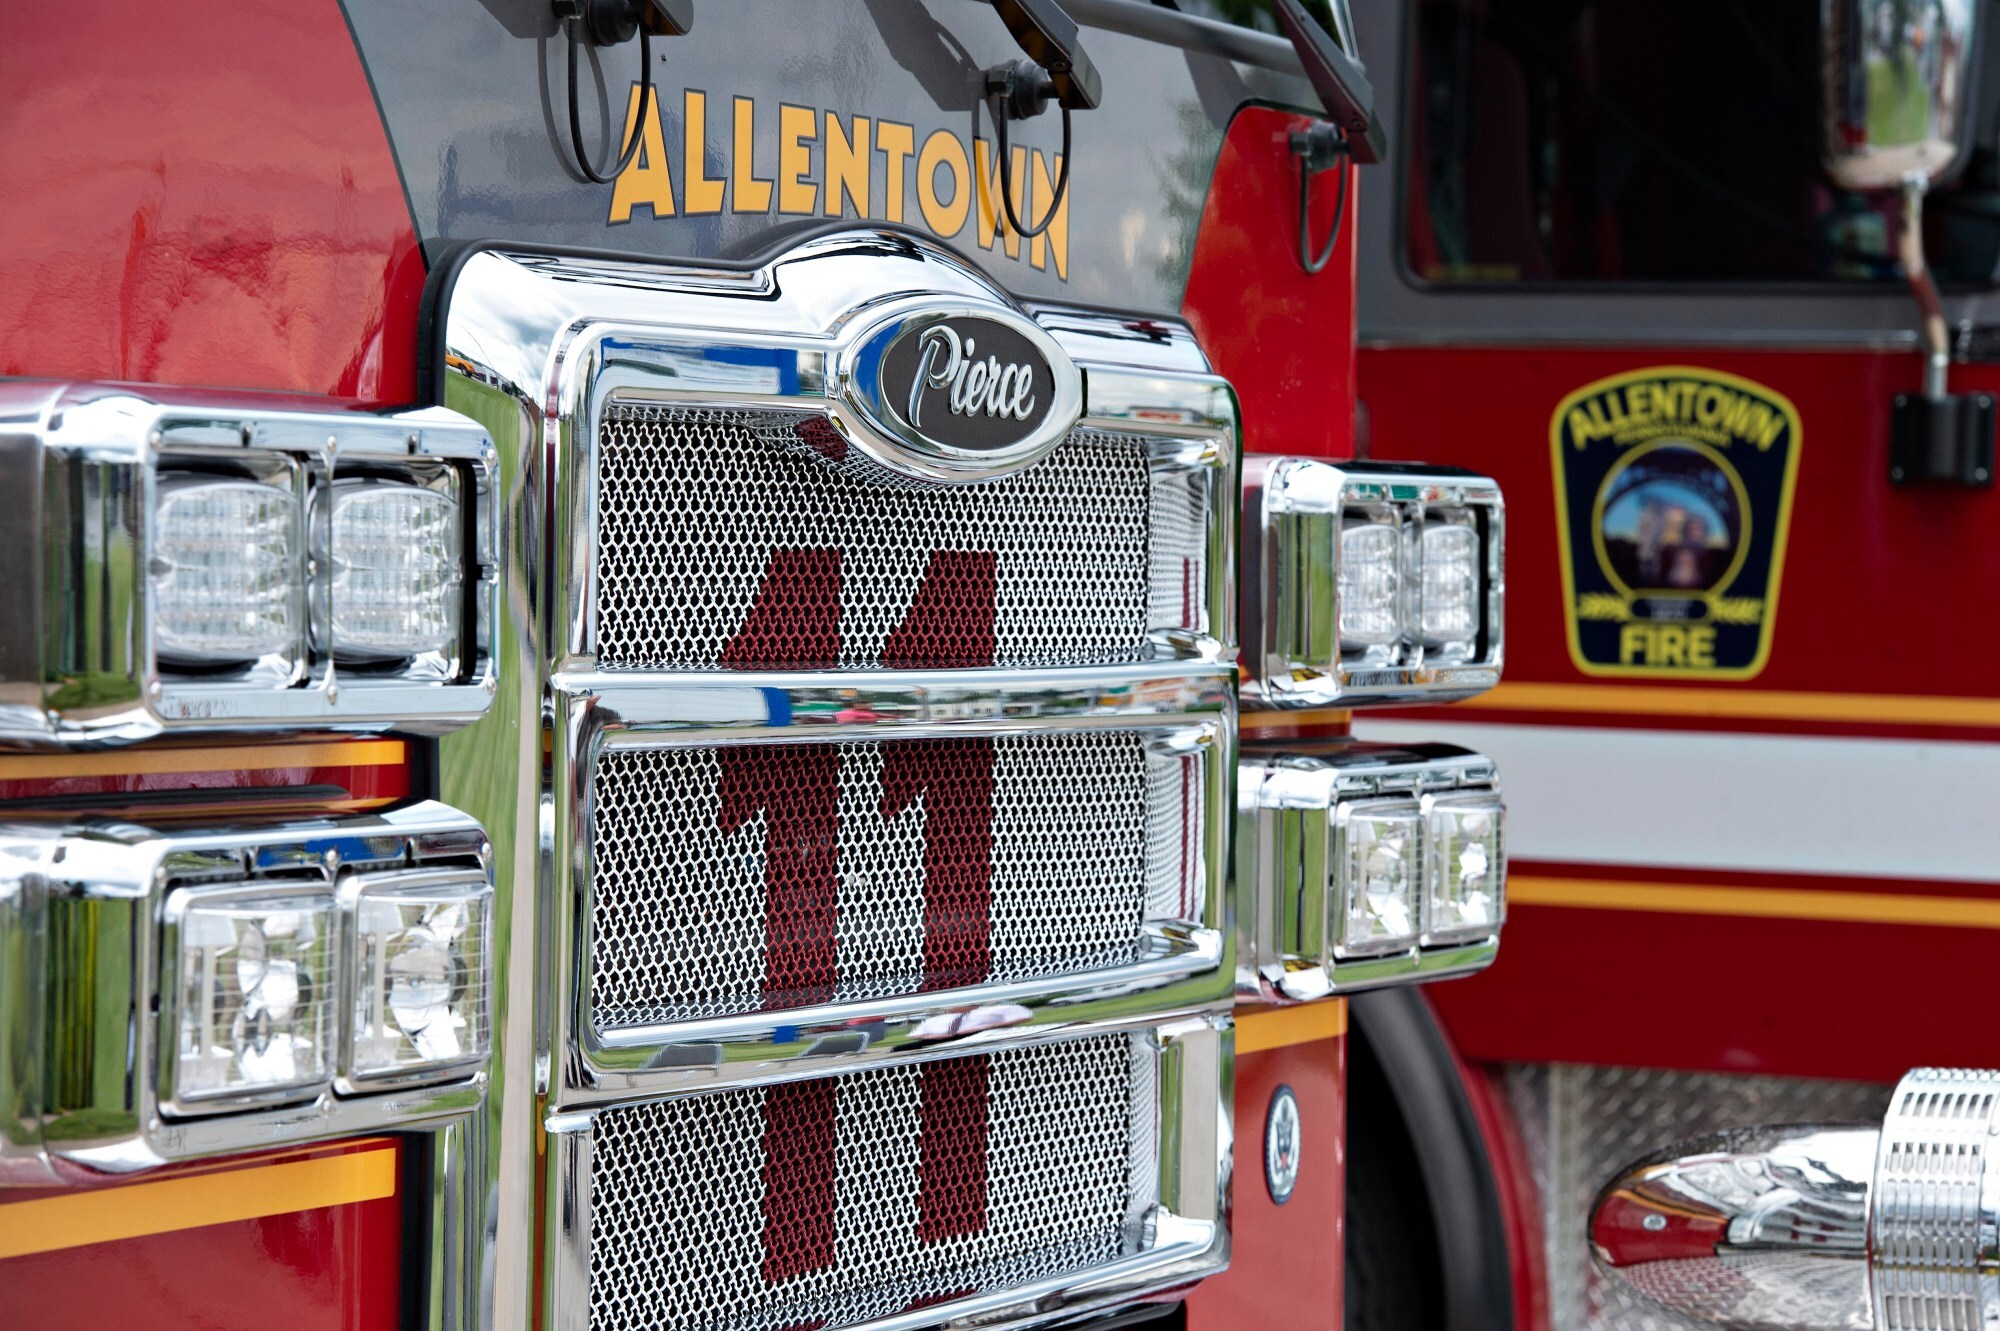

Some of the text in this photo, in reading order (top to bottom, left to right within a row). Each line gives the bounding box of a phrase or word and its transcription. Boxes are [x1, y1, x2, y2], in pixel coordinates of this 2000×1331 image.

[607, 80, 1069, 283] ALLENTOWN
[908, 325, 1036, 428] Pierce
[1567, 381, 1786, 451] ALLENTOWN
[1619, 624, 1716, 667] FIRE
[718, 549, 997, 1284] 11
